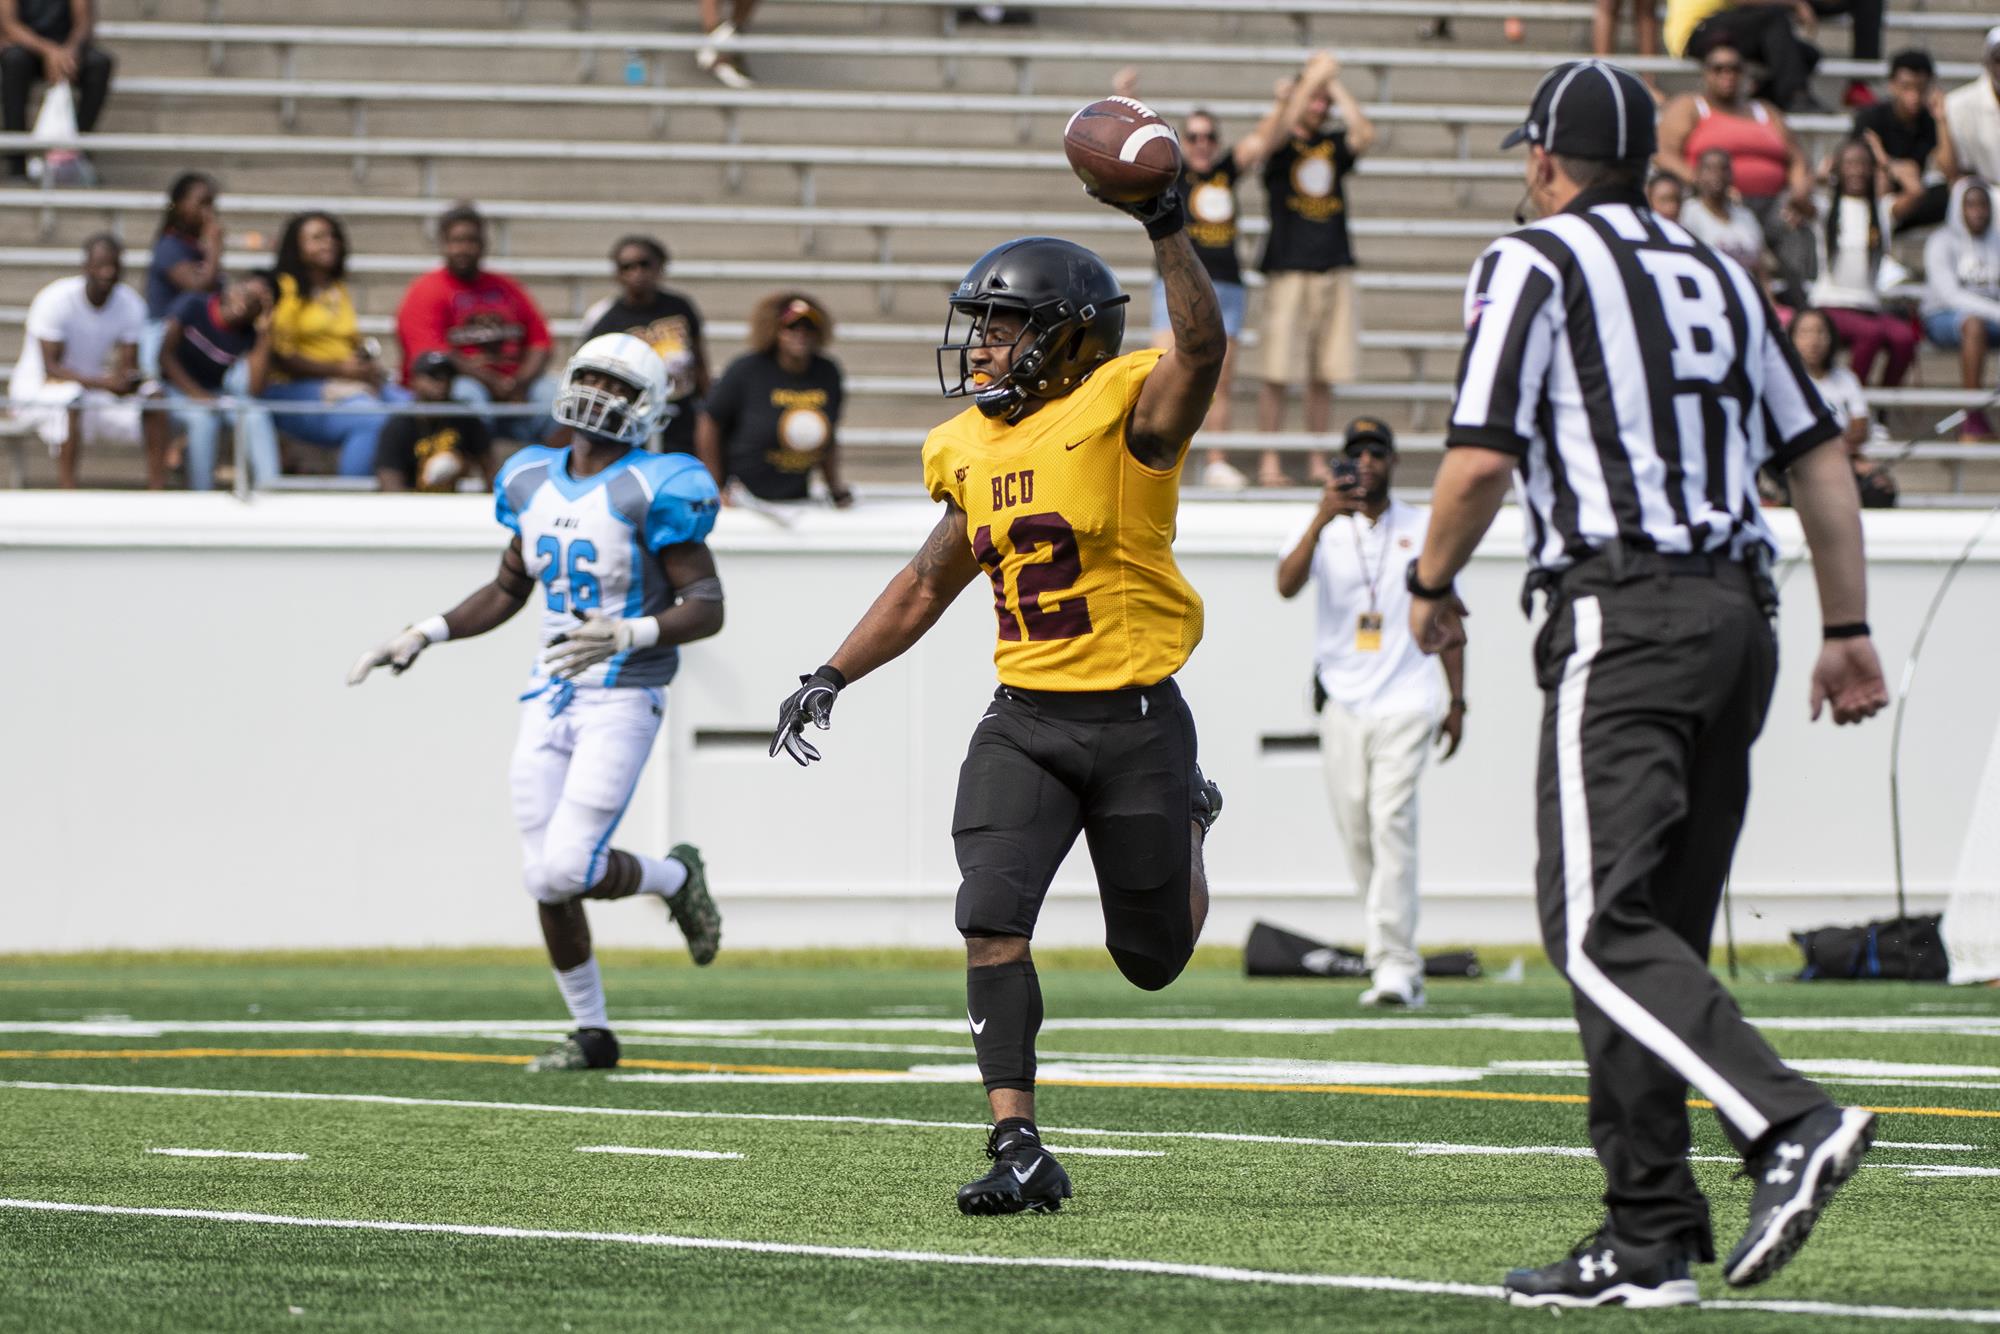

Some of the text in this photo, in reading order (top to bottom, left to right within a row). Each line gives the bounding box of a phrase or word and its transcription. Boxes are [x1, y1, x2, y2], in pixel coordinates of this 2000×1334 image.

[1634, 248, 1737, 384] B
[536, 534, 600, 613] 26
[972, 511, 1094, 642] 12
